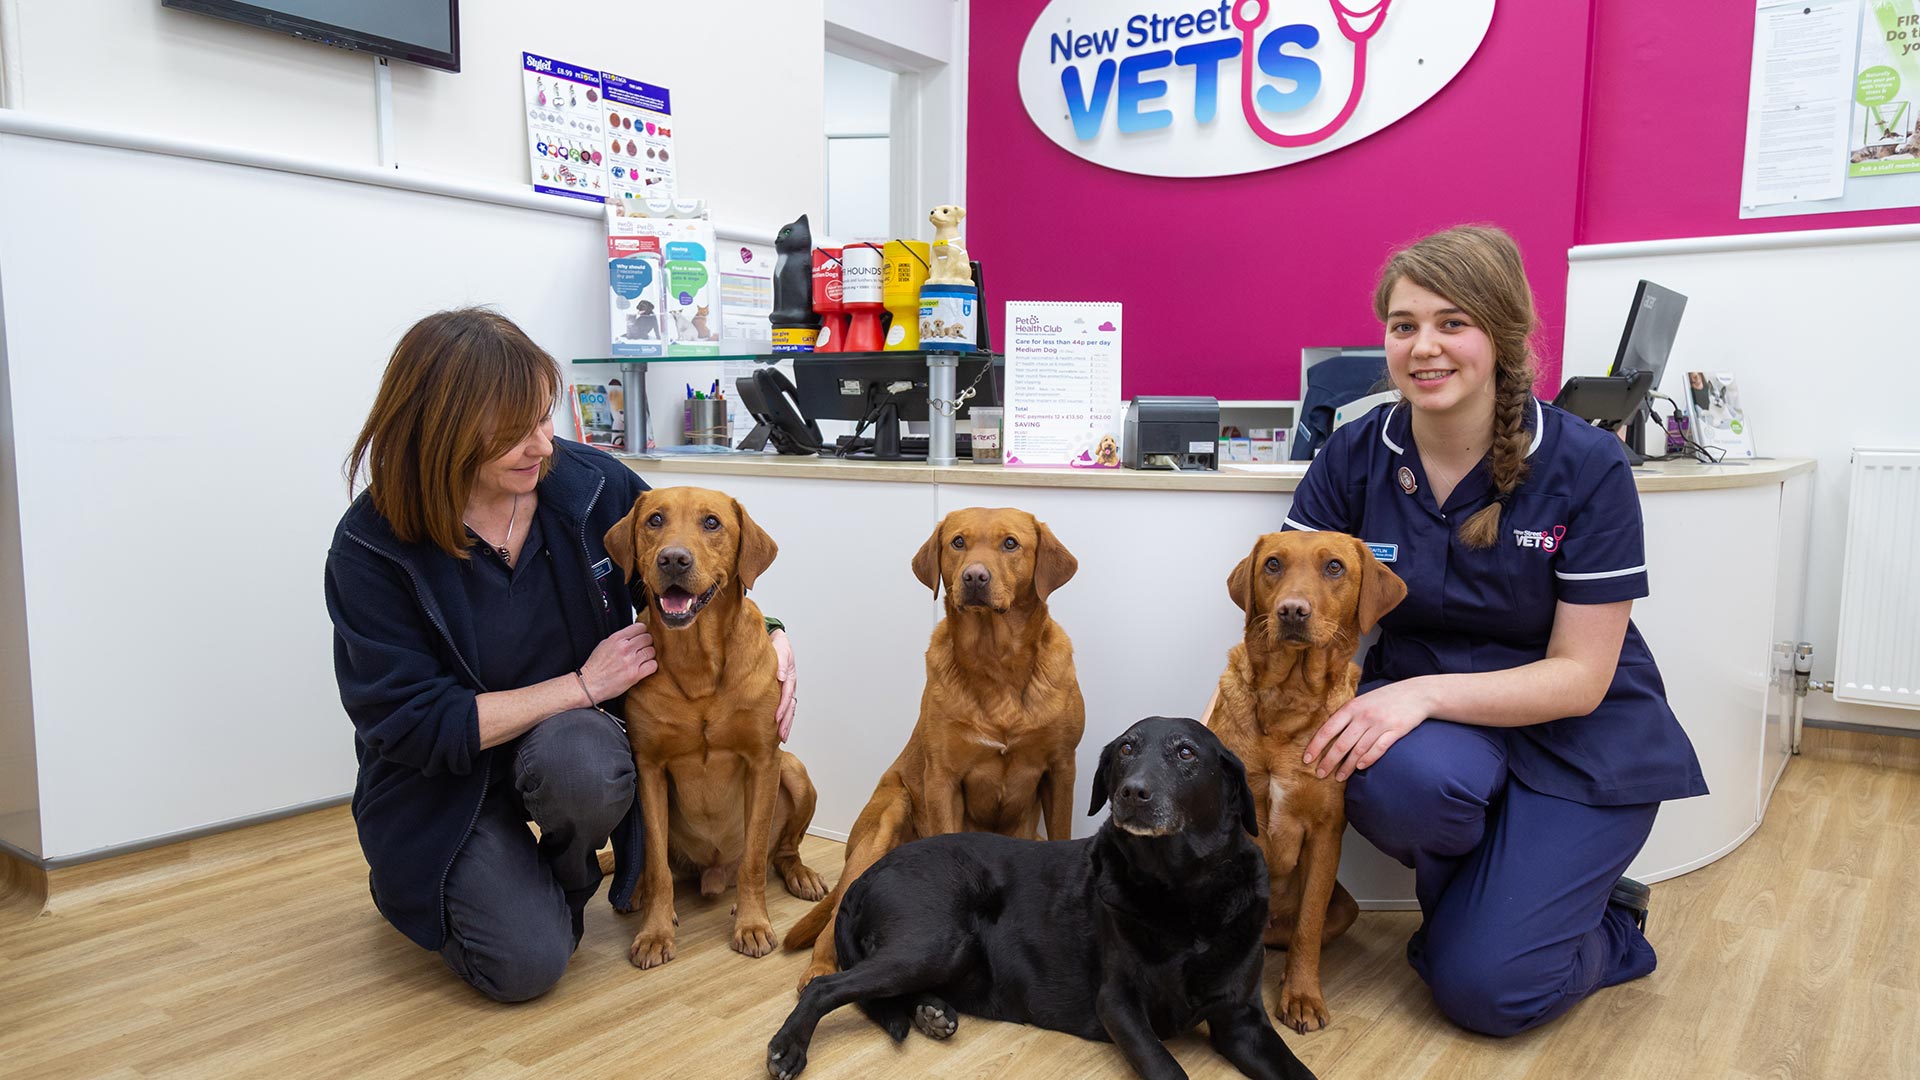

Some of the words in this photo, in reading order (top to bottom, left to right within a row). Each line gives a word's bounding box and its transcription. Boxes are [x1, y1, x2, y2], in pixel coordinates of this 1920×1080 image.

[1050, 27, 1119, 64] New
[1126, 0, 1232, 48] Street
[1886, 30, 1907, 41] Do
[1061, 23, 1322, 141] VETS
[1015, 316, 1029, 325] Pet
[1015, 325, 1042, 333] Health
[1043, 325, 1063, 333] Club
[1515, 534, 1554, 548] VETS
